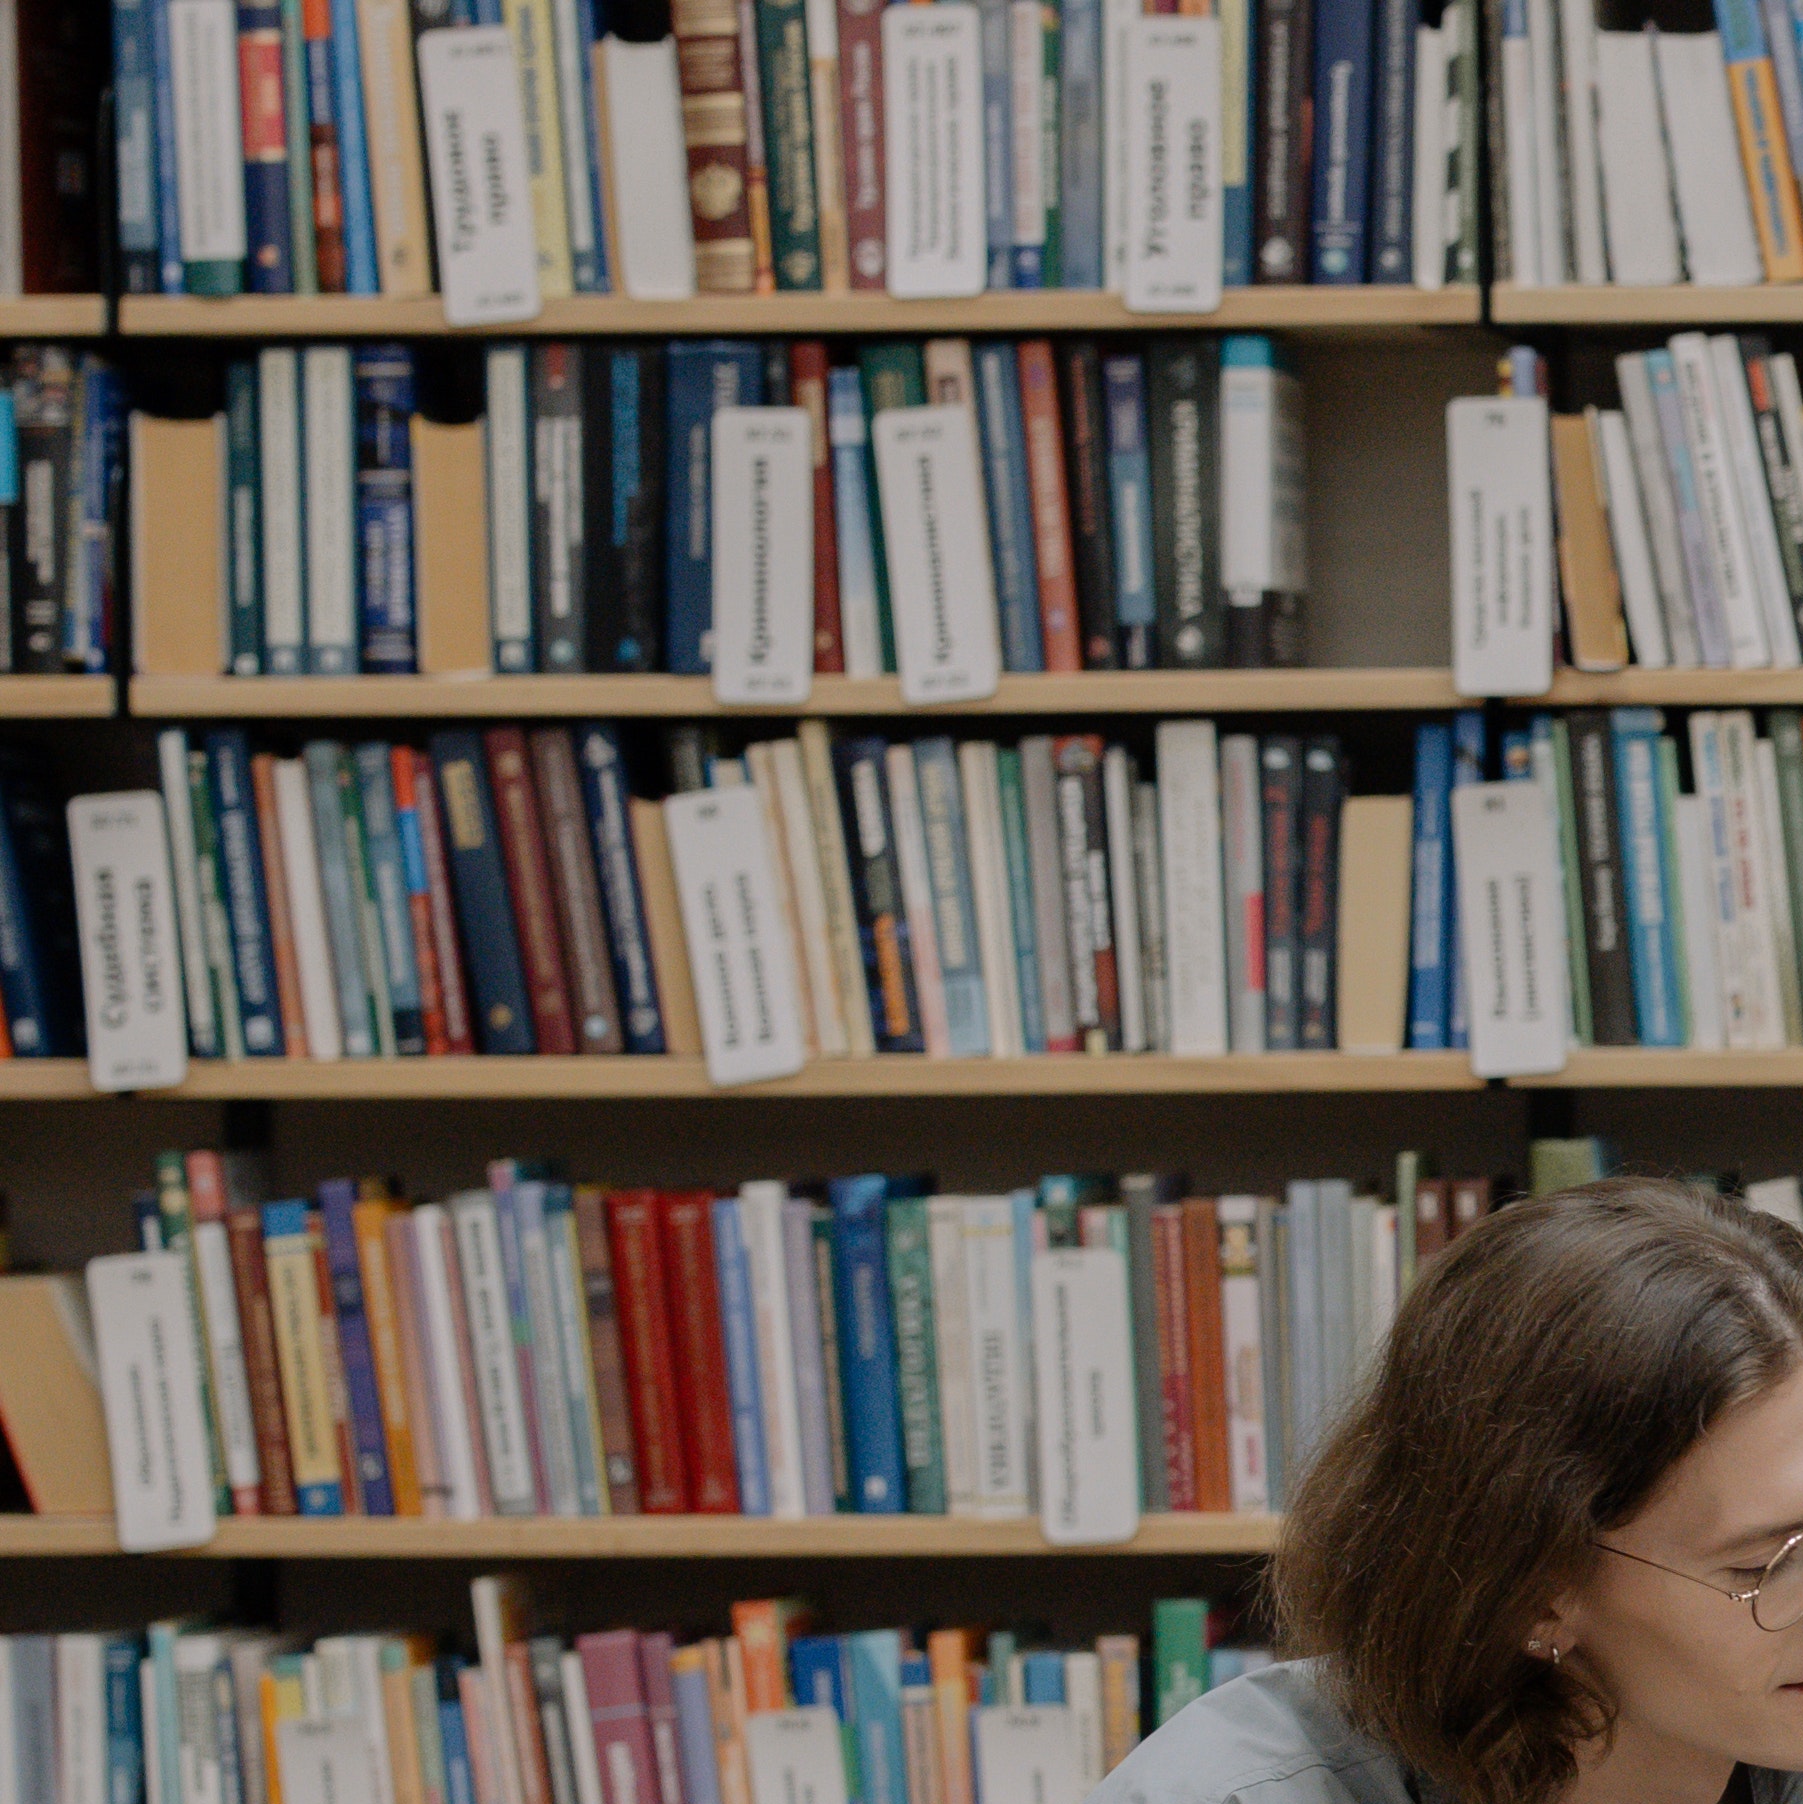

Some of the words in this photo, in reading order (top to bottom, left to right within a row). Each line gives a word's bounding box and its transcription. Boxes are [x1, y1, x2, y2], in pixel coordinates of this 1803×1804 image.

[441, 108, 470, 256] Трудовое
[485, 131, 507, 227] право
[1140, 79, 1170, 260] Уголовное
[1189, 121, 1211, 222] право
[746, 453, 771, 674] Криминология
[915, 452, 954, 668] Криминалистика
[1167, 398, 1203, 620] КРИМИНАЛИСТИКА
[102, 865, 129, 1031] Судебная
[139, 877, 163, 1012] система
[733, 871, 762, 944] наука
[710, 951, 742, 1050] Военное
[745, 946, 775, 1048] Военная
